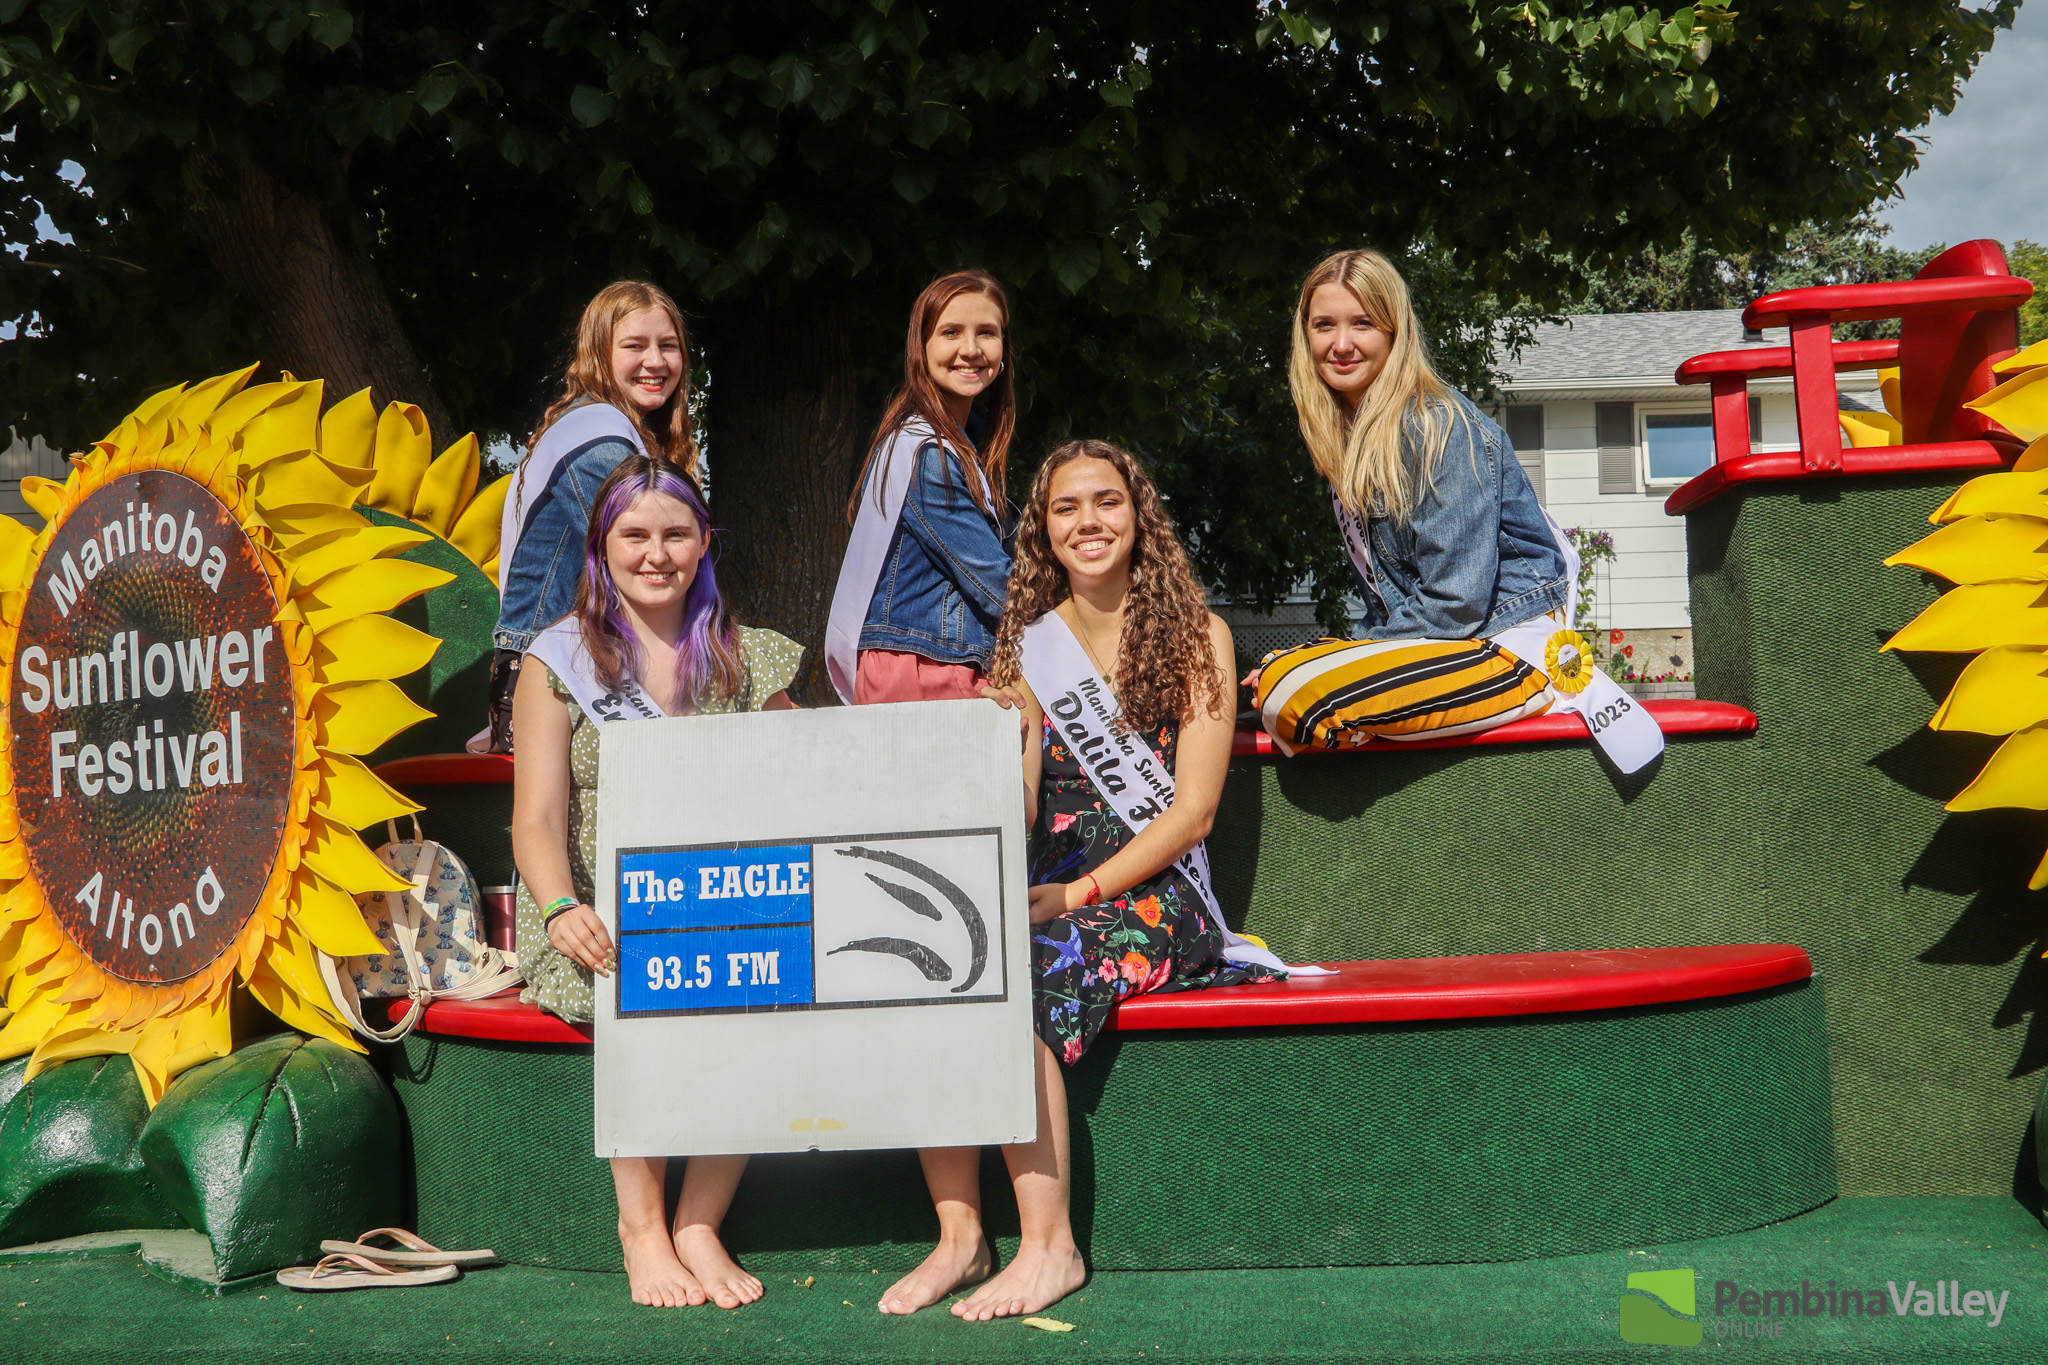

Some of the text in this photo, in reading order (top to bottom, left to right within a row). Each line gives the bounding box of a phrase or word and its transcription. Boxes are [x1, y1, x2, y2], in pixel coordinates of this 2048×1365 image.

[47, 501, 228, 618] Manitoba
[20, 624, 273, 714] Sunflower
[51, 711, 243, 798] Festival
[1050, 691, 1127, 796] Dalila
[1588, 697, 1631, 734] 2023
[75, 865, 226, 956] Altona
[623, 862, 810, 904] The EAGLE
[647, 951, 780, 990] 93.5 FM
